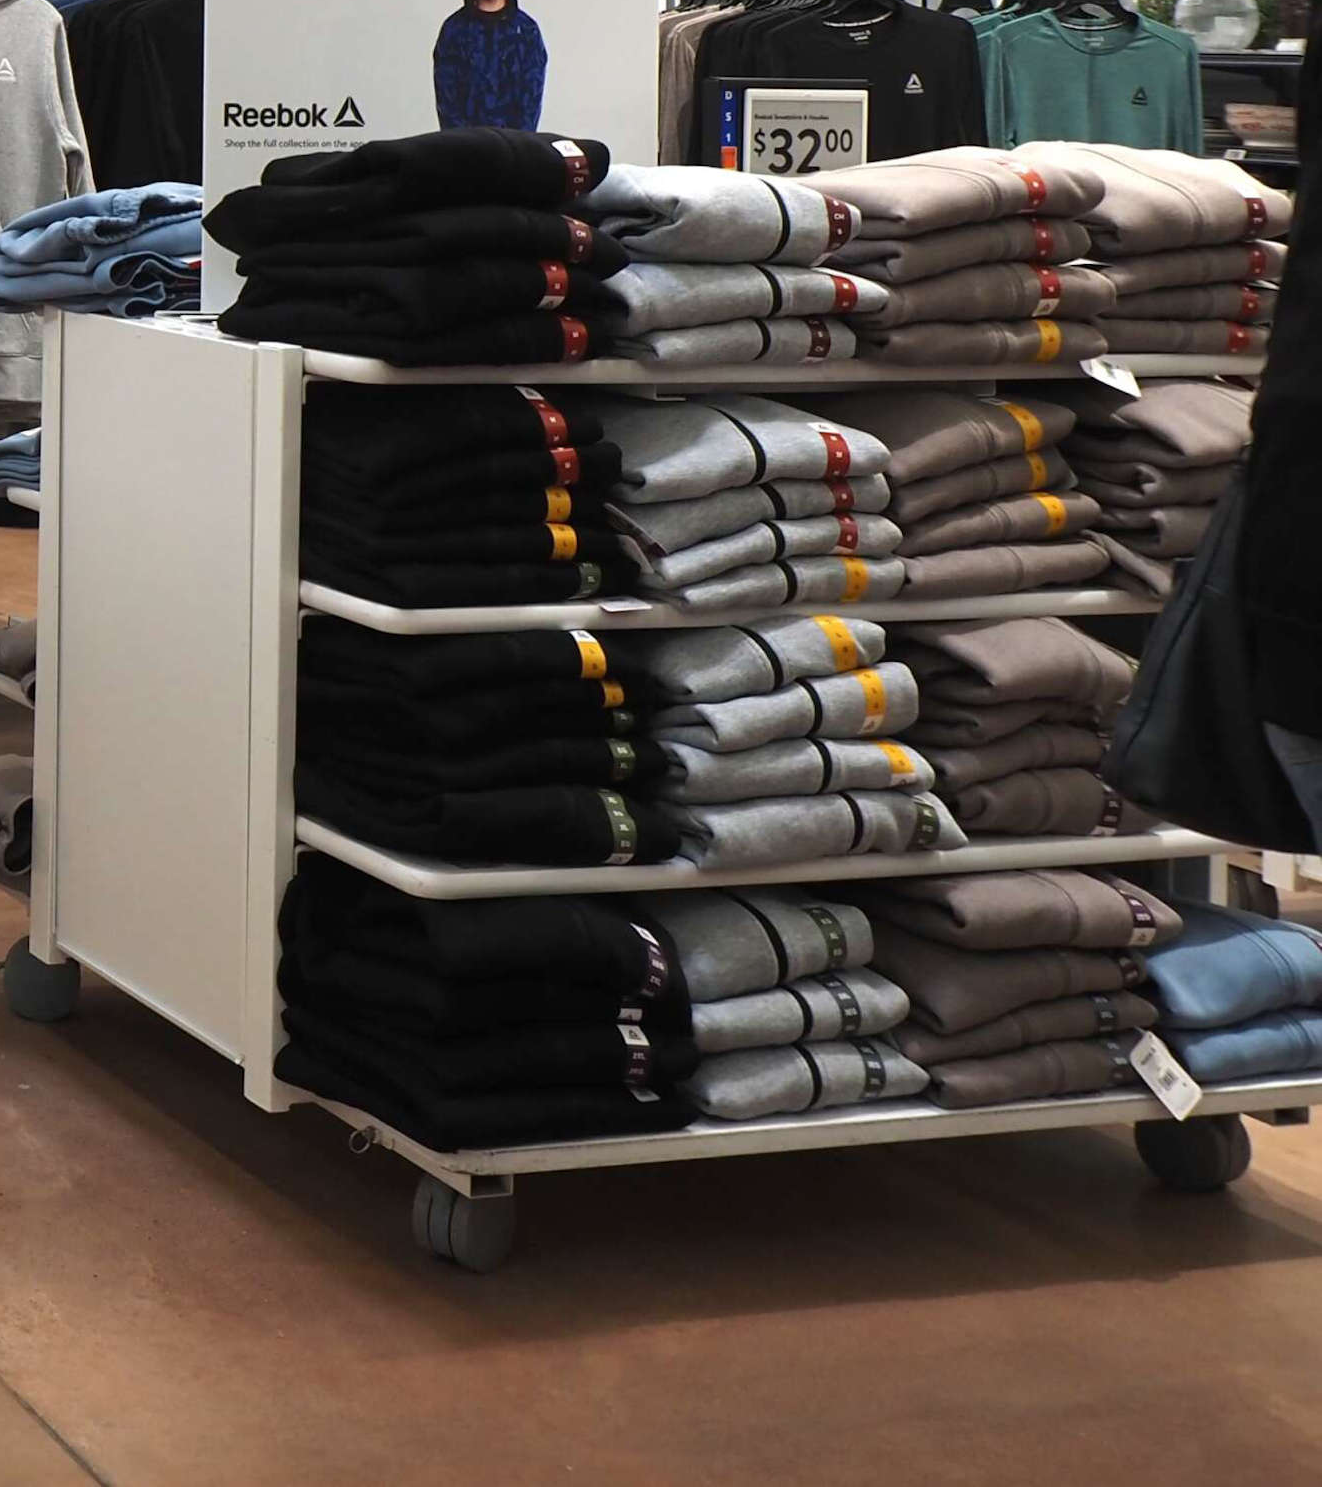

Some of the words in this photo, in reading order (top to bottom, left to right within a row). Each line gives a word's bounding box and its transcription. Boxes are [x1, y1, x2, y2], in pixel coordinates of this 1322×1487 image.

[223, 103, 329, 128] Reebok
[224, 139, 246, 150] Shop
[247, 139, 261, 148] the
[263, 139, 277, 148] full
[278, 139, 319, 148] collection
[333, 139, 348, 148] the
